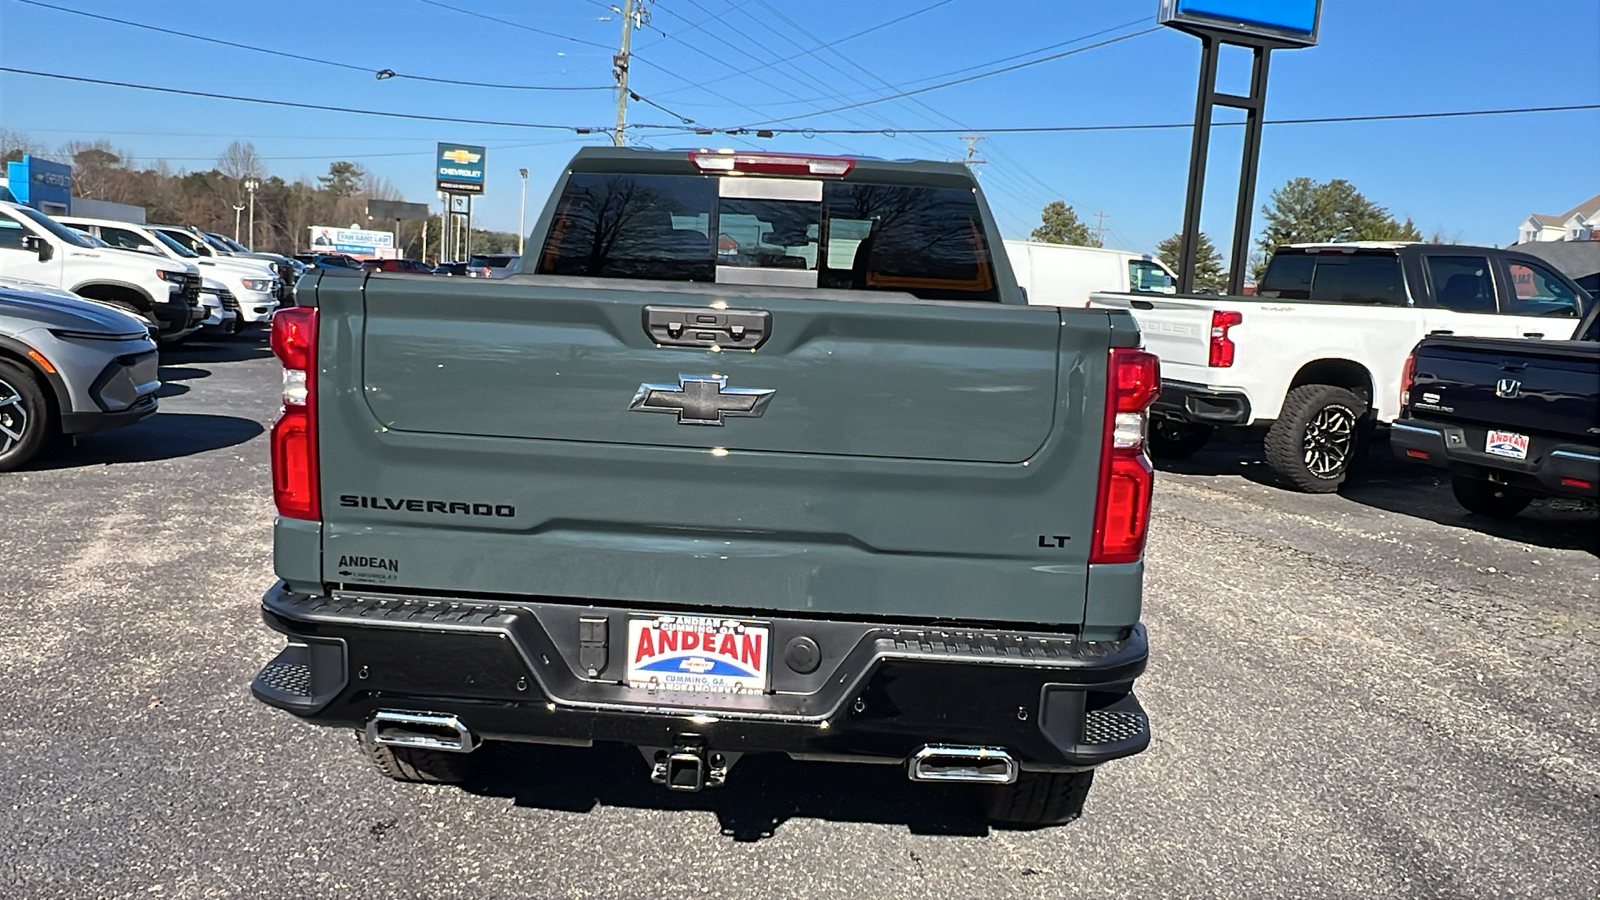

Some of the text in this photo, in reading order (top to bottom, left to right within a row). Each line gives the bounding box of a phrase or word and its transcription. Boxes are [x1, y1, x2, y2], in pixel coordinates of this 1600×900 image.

[440, 167, 481, 178] CHEVROLET
[339, 232, 354, 241] VAN
[1490, 433, 1527, 450] ANDEAN
[340, 494, 515, 517] SILVERADO
[1038, 535, 1071, 548] LT
[338, 554, 399, 572] ANDEAN
[675, 616, 721, 628] ANDEAN
[634, 626, 762, 672] ANDEAN
